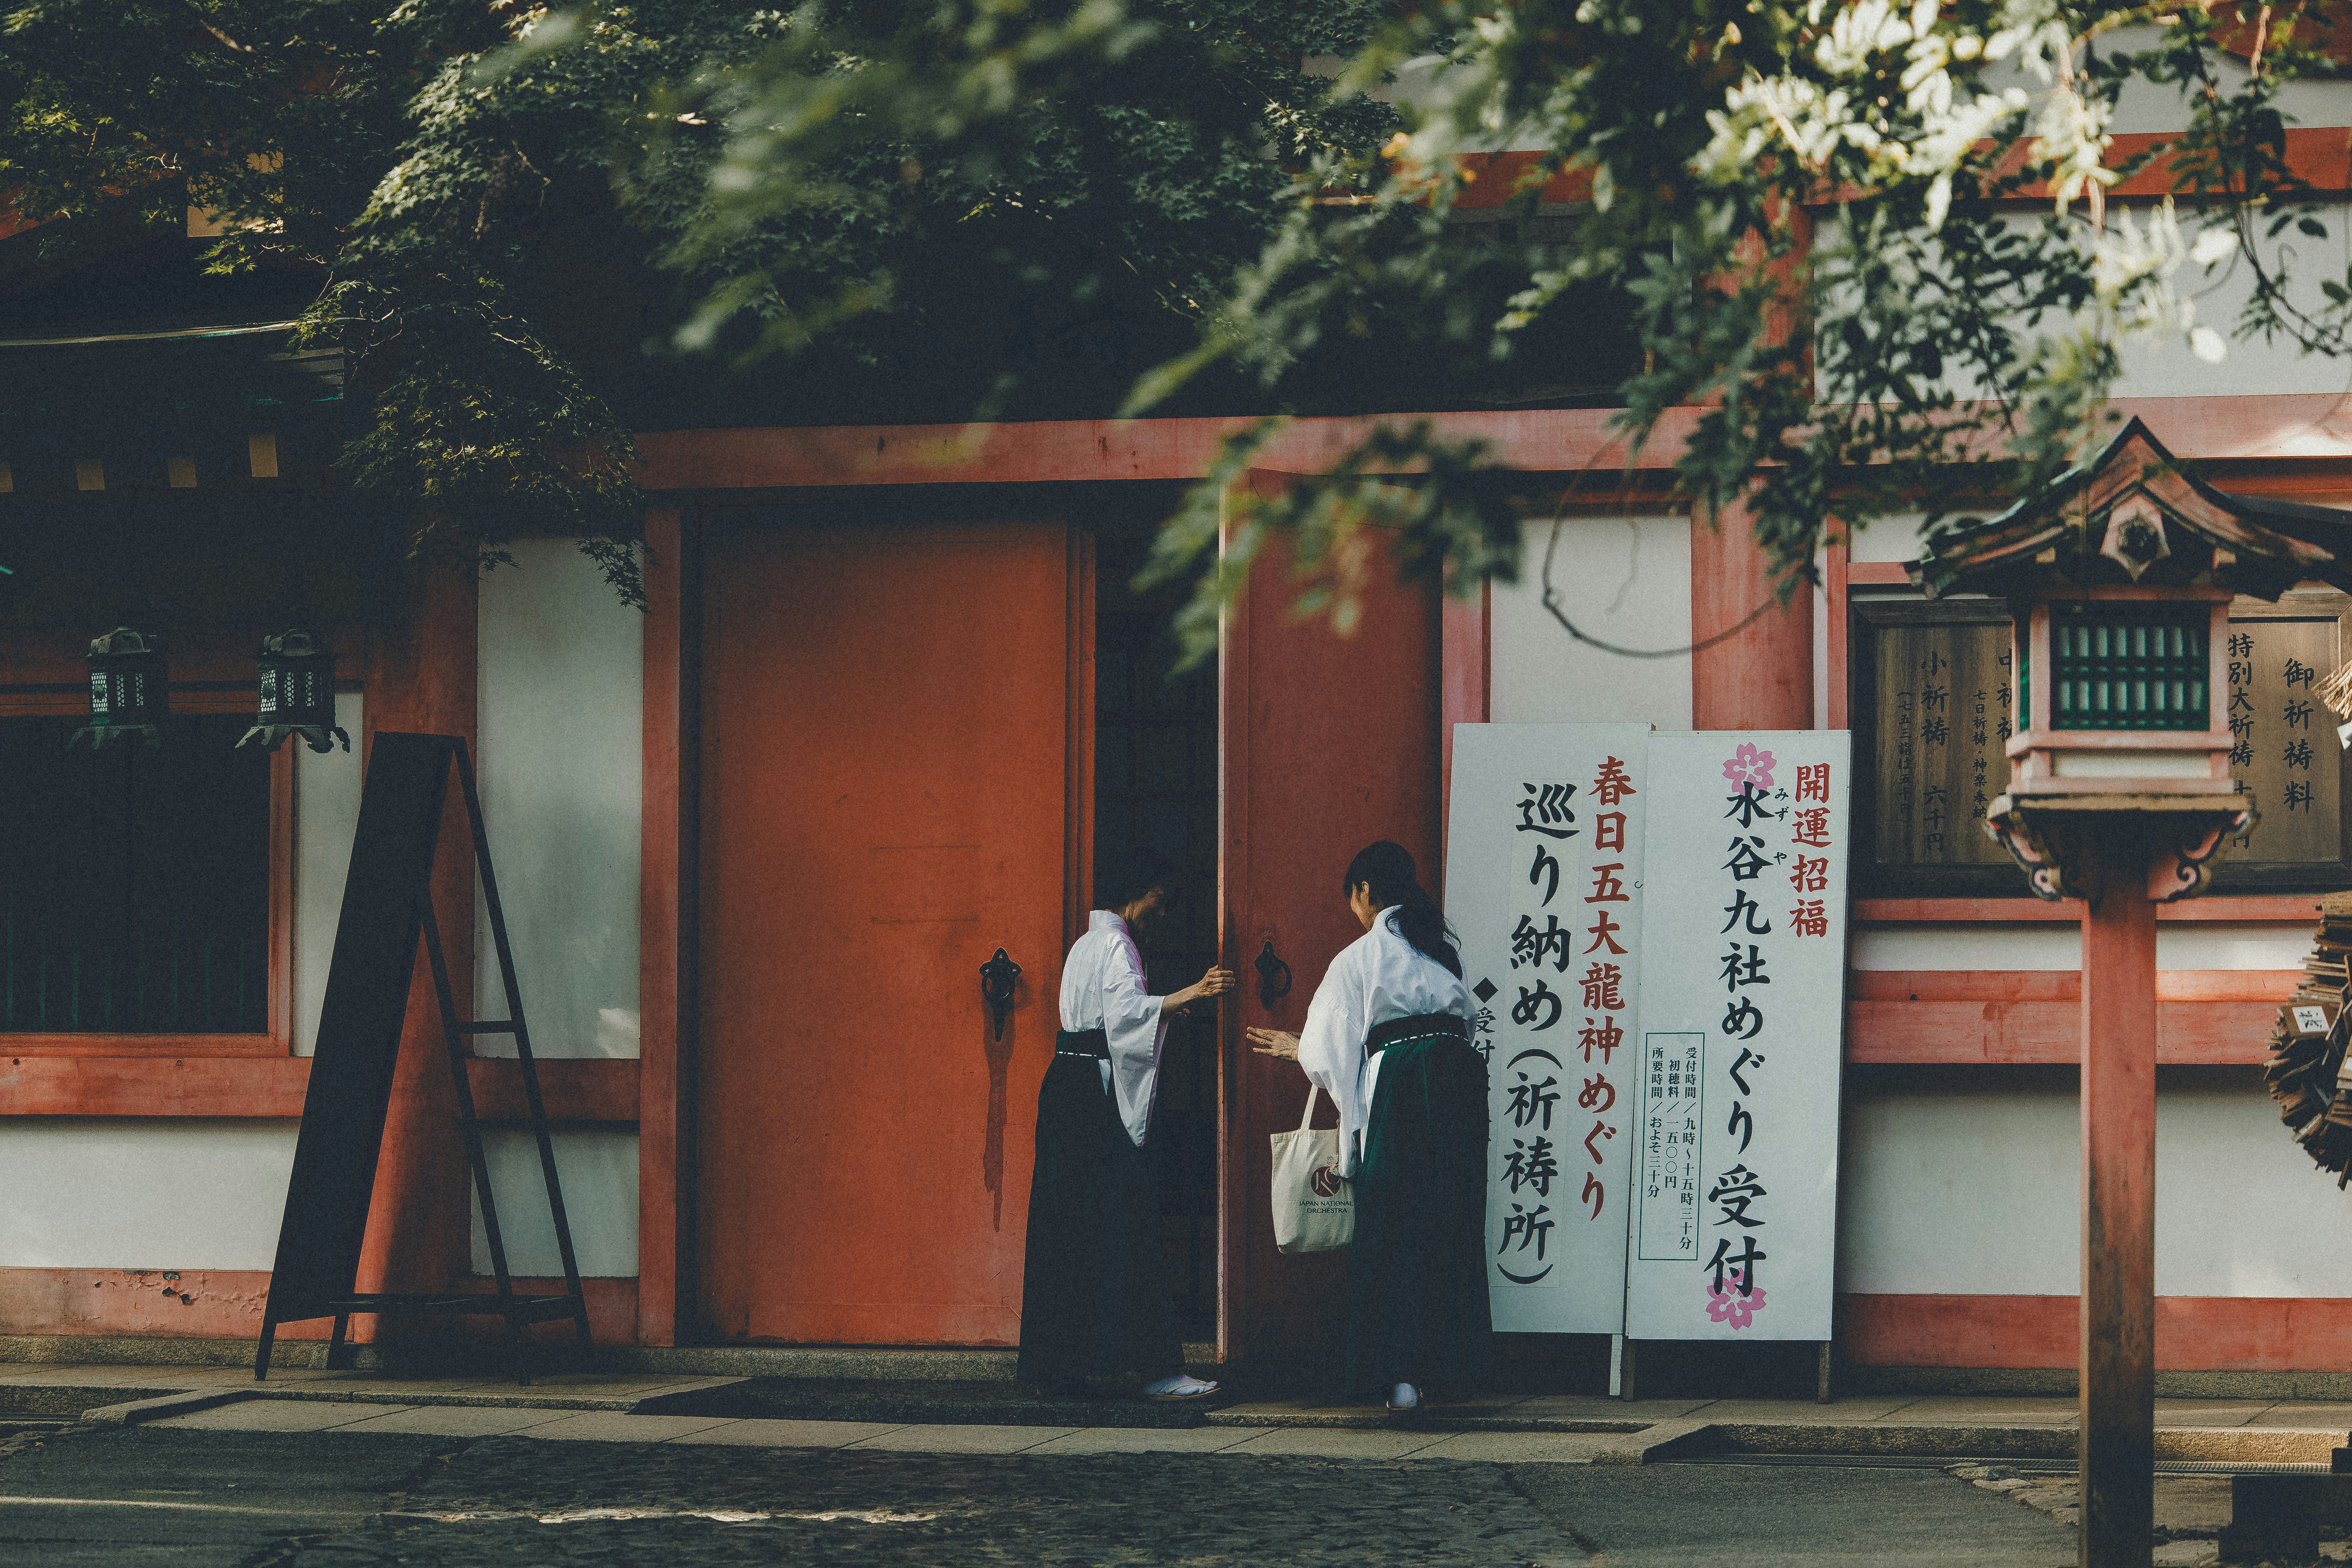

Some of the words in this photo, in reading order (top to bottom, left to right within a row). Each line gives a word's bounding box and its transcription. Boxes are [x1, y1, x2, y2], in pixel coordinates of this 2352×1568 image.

[1921, 650, 1950, 747] 小祈祷
[2228, 633, 2255, 767] 特別大祈祷
[2283, 657, 2314, 814] 御祈祷料
[1789, 763, 1832, 938] 開運招福
[1922, 785, 1948, 853] 六千円
[1576, 755, 1636, 1221] 春日五大龍神めぐり
[1703, 782, 1774, 1297] 水谷九社めぐり受付
